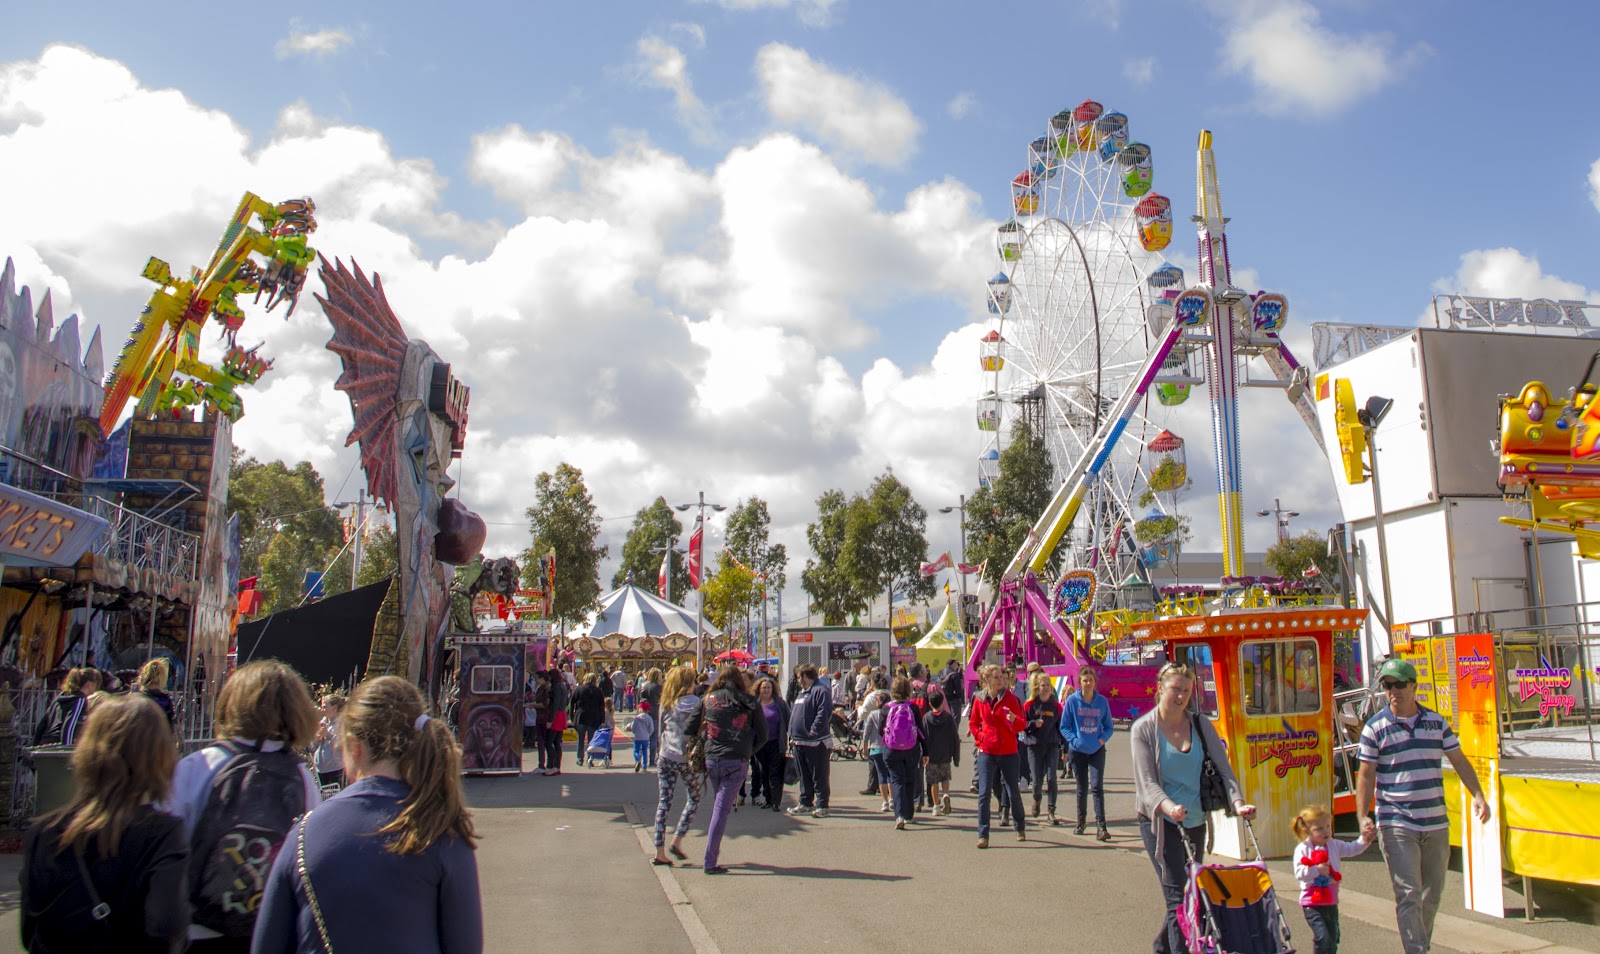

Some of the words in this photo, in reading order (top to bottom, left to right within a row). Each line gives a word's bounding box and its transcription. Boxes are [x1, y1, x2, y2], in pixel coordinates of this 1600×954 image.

[1458, 647, 1490, 680] TECHNO
[1516, 654, 1571, 702] TECHNO
[1539, 687, 1576, 716] Jump
[1246, 716, 1319, 768] TECHNO
[1275, 750, 1322, 778] Jump
